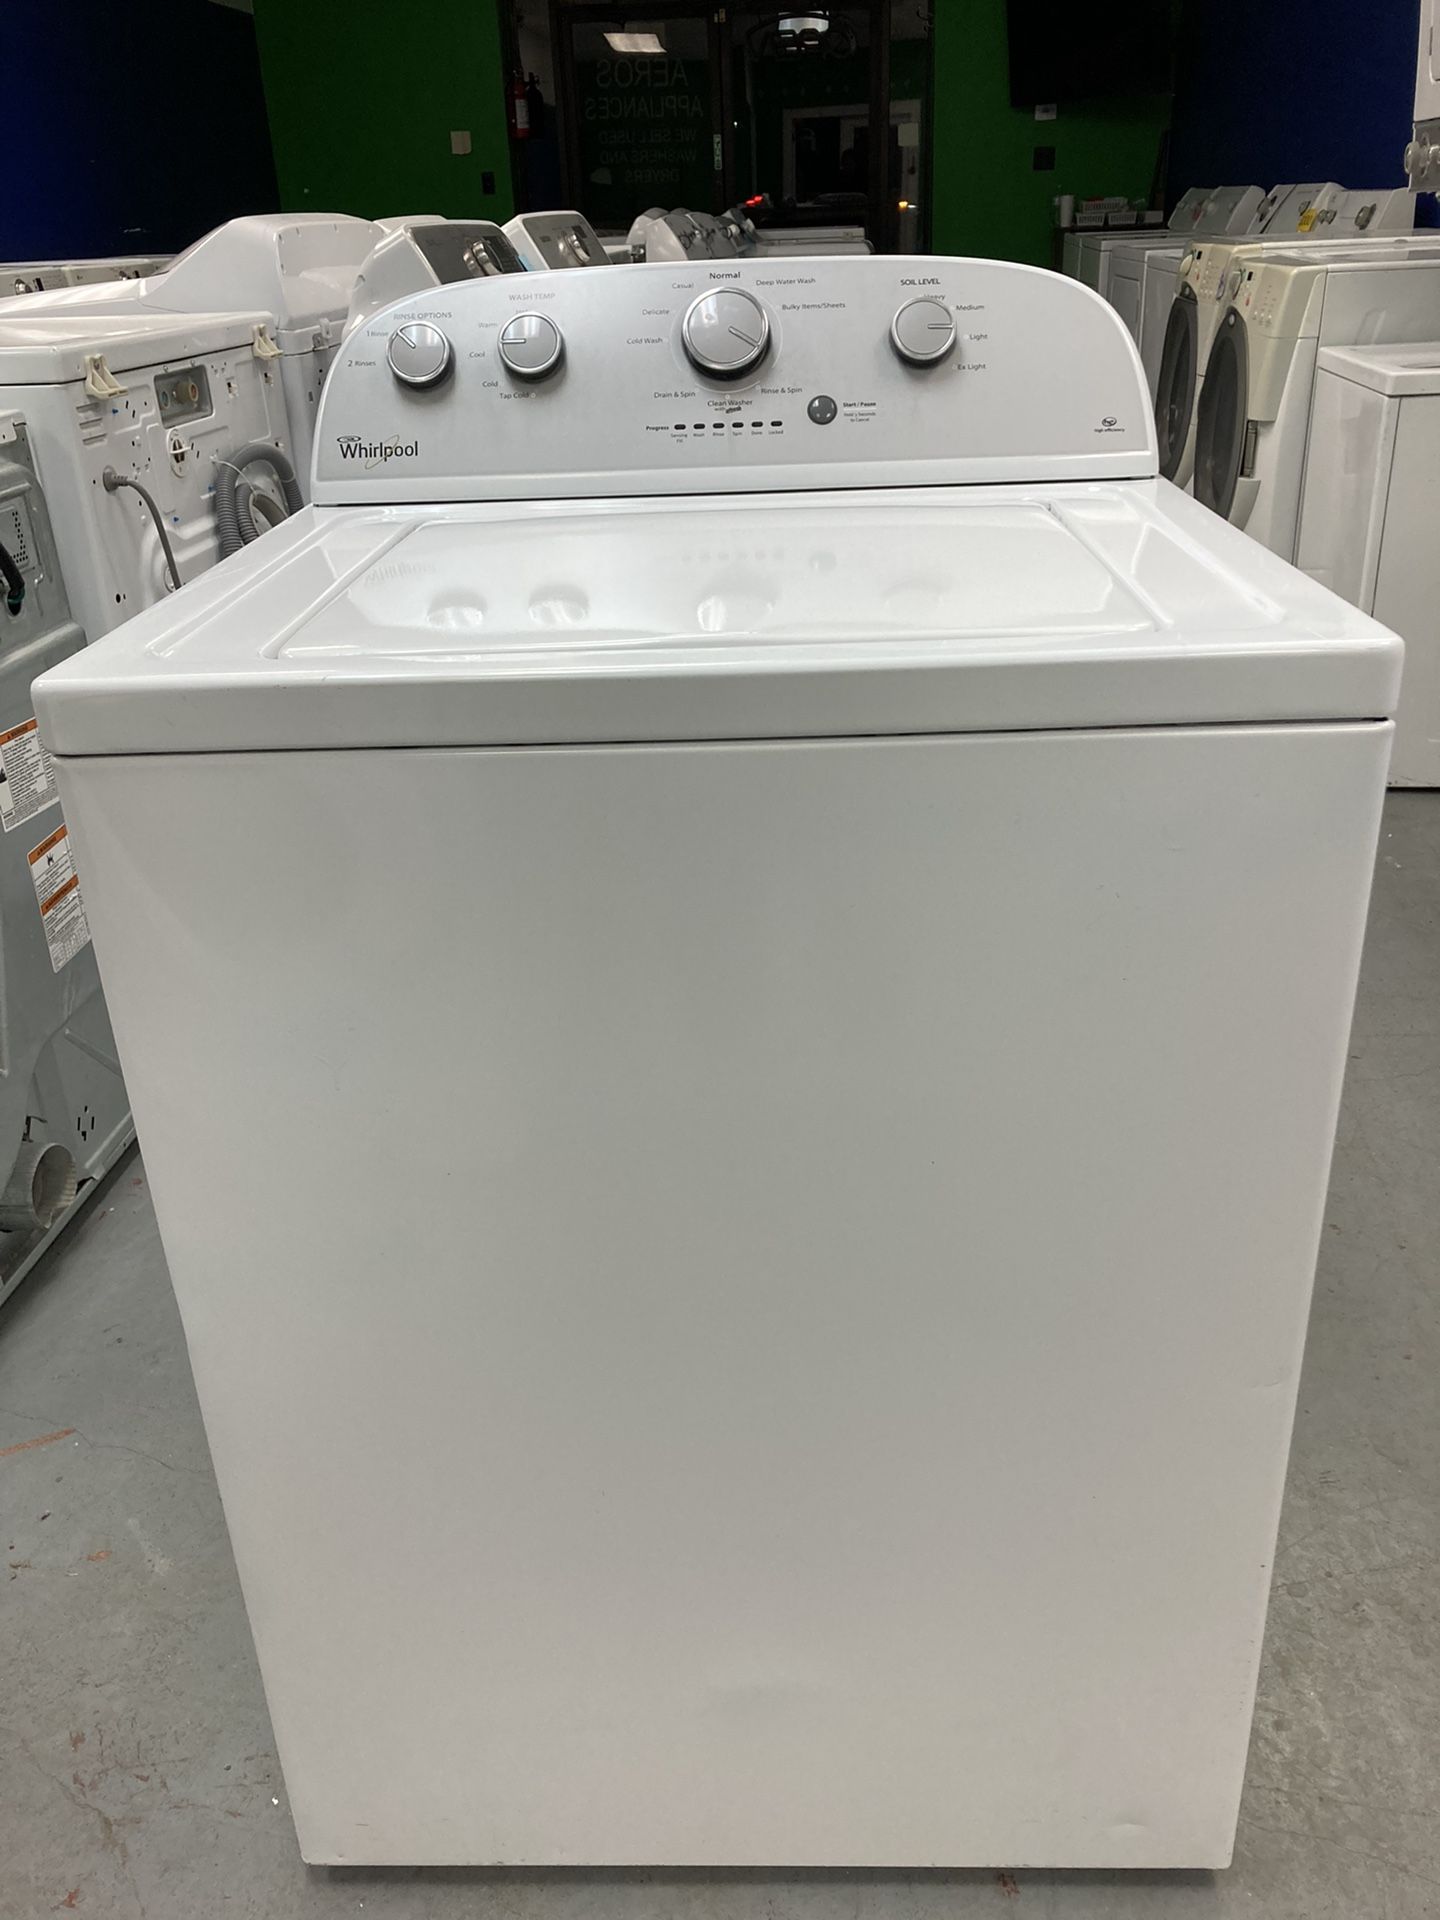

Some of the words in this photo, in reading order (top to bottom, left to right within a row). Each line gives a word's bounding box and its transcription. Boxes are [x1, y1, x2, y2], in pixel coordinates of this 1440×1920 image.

[709, 271, 741, 280] Normal
[672, 281, 694, 289] Casual
[755, 279, 775, 287] Deep
[900, 278, 917, 286] SOIL
[918, 278, 941, 286] LEVEL
[508, 292, 533, 301] WASH
[534, 292, 556, 300] TEMP
[781, 303, 800, 311] Bulky
[801, 302, 846, 310] Items/Sheets
[393, 311, 417, 321] RINSE
[417, 310, 453, 320] OPTIONS
[642, 308, 670, 316] Delicate
[626, 337, 643, 345] Cold
[644, 336, 664, 344] Wash
[969, 333, 988, 341] Light
[469, 351, 486, 359] Cool
[347, 359, 353, 367] 2
[967, 363, 987, 371] Light
[482, 380, 499, 388] Cold
[653, 391, 673, 399] Drain
[680, 391, 696, 399] Spin
[786, 387, 803, 395] Spin
[499, 392, 512, 400] Tap
[513, 391, 530, 399] Cold
[339, 440, 419, 462] Whirlpool
